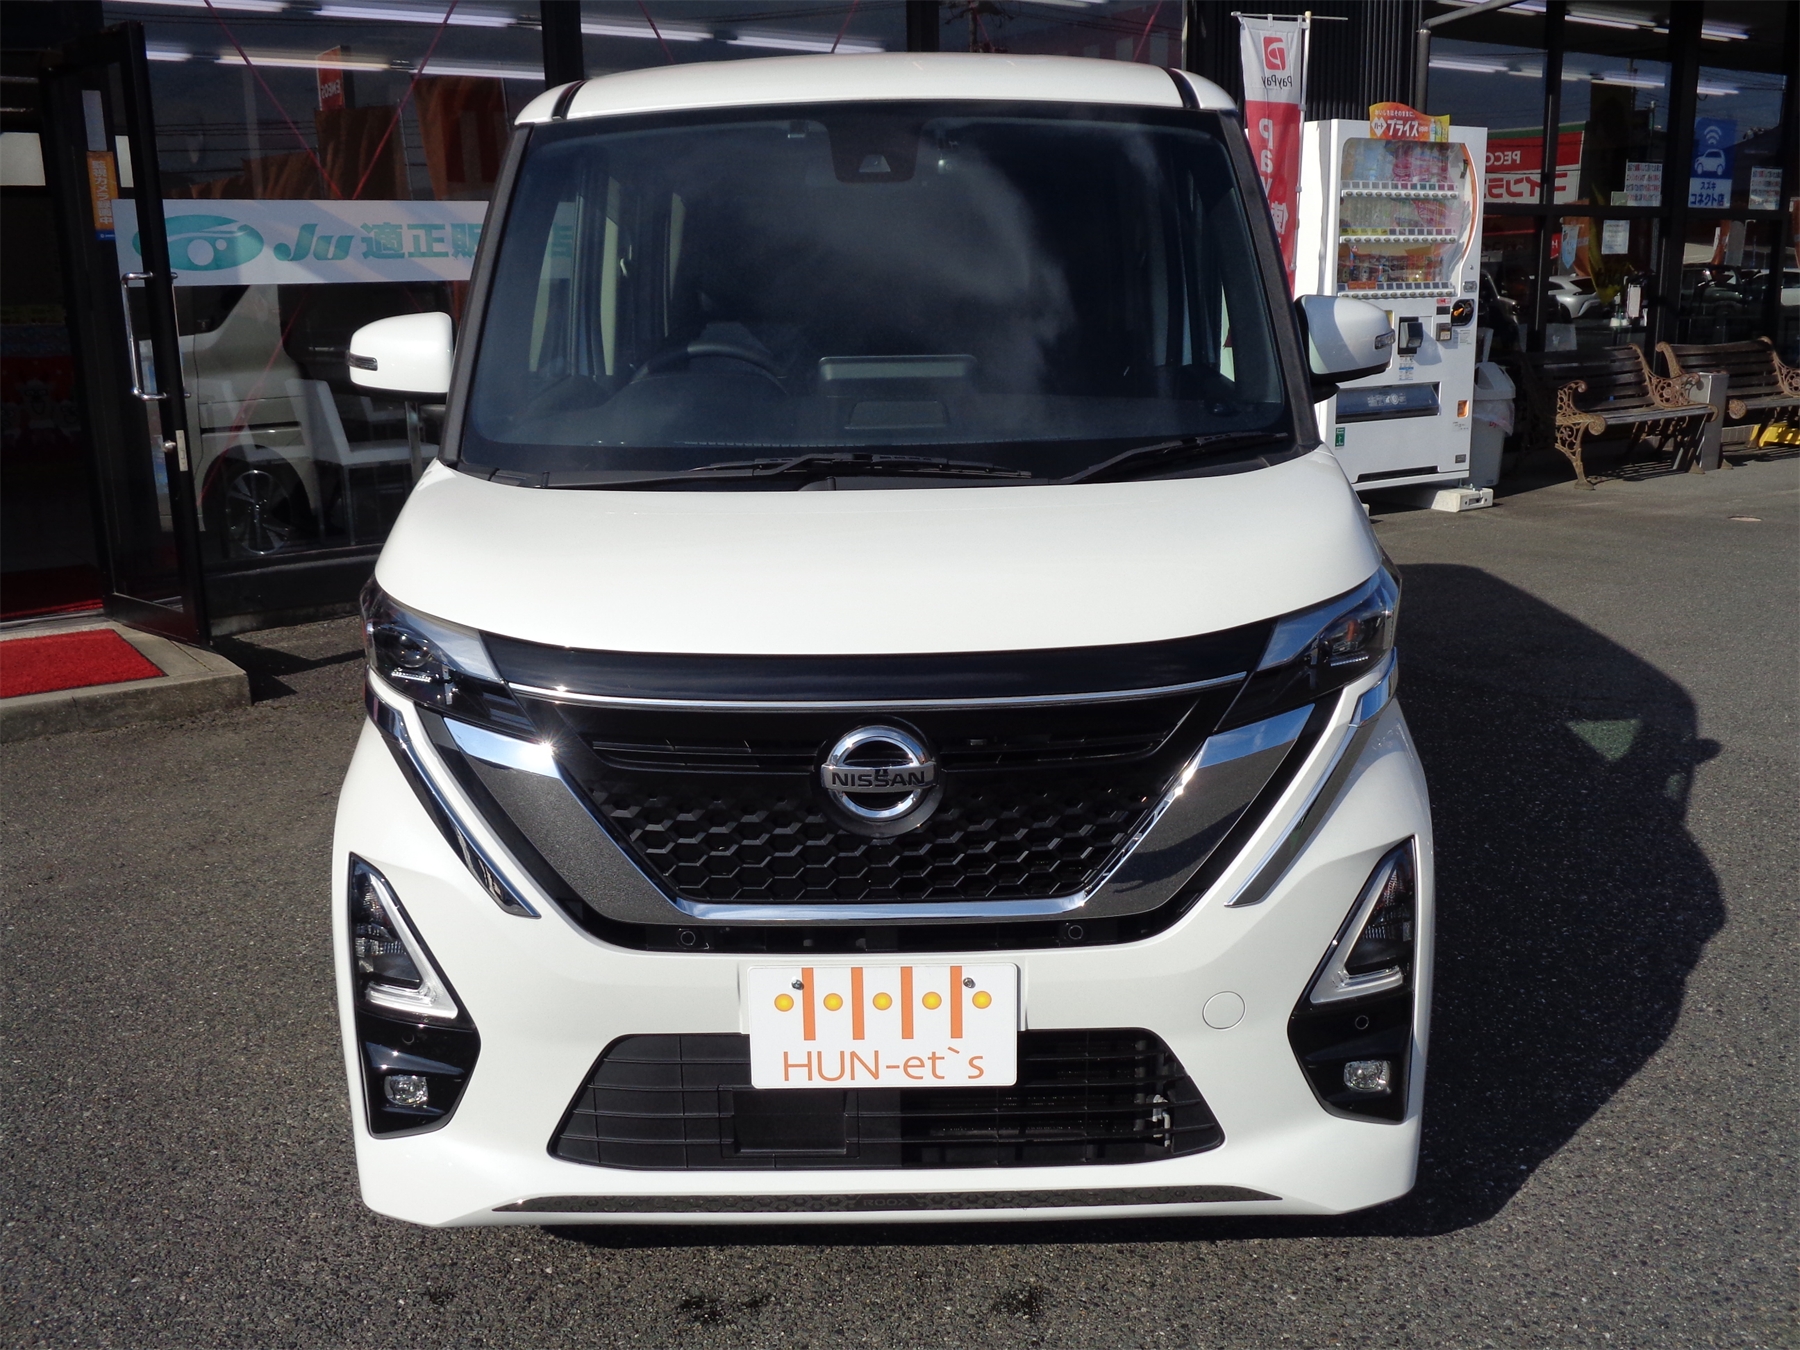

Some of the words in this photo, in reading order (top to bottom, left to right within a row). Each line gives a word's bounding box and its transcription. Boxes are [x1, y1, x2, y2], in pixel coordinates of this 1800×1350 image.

[1700, 181, 1717, 191] スズキ
[1690, 193, 1725, 206] コネクト店
[831, 770, 926, 788] NISSAN
[863, 1198, 909, 1206] ROOX
